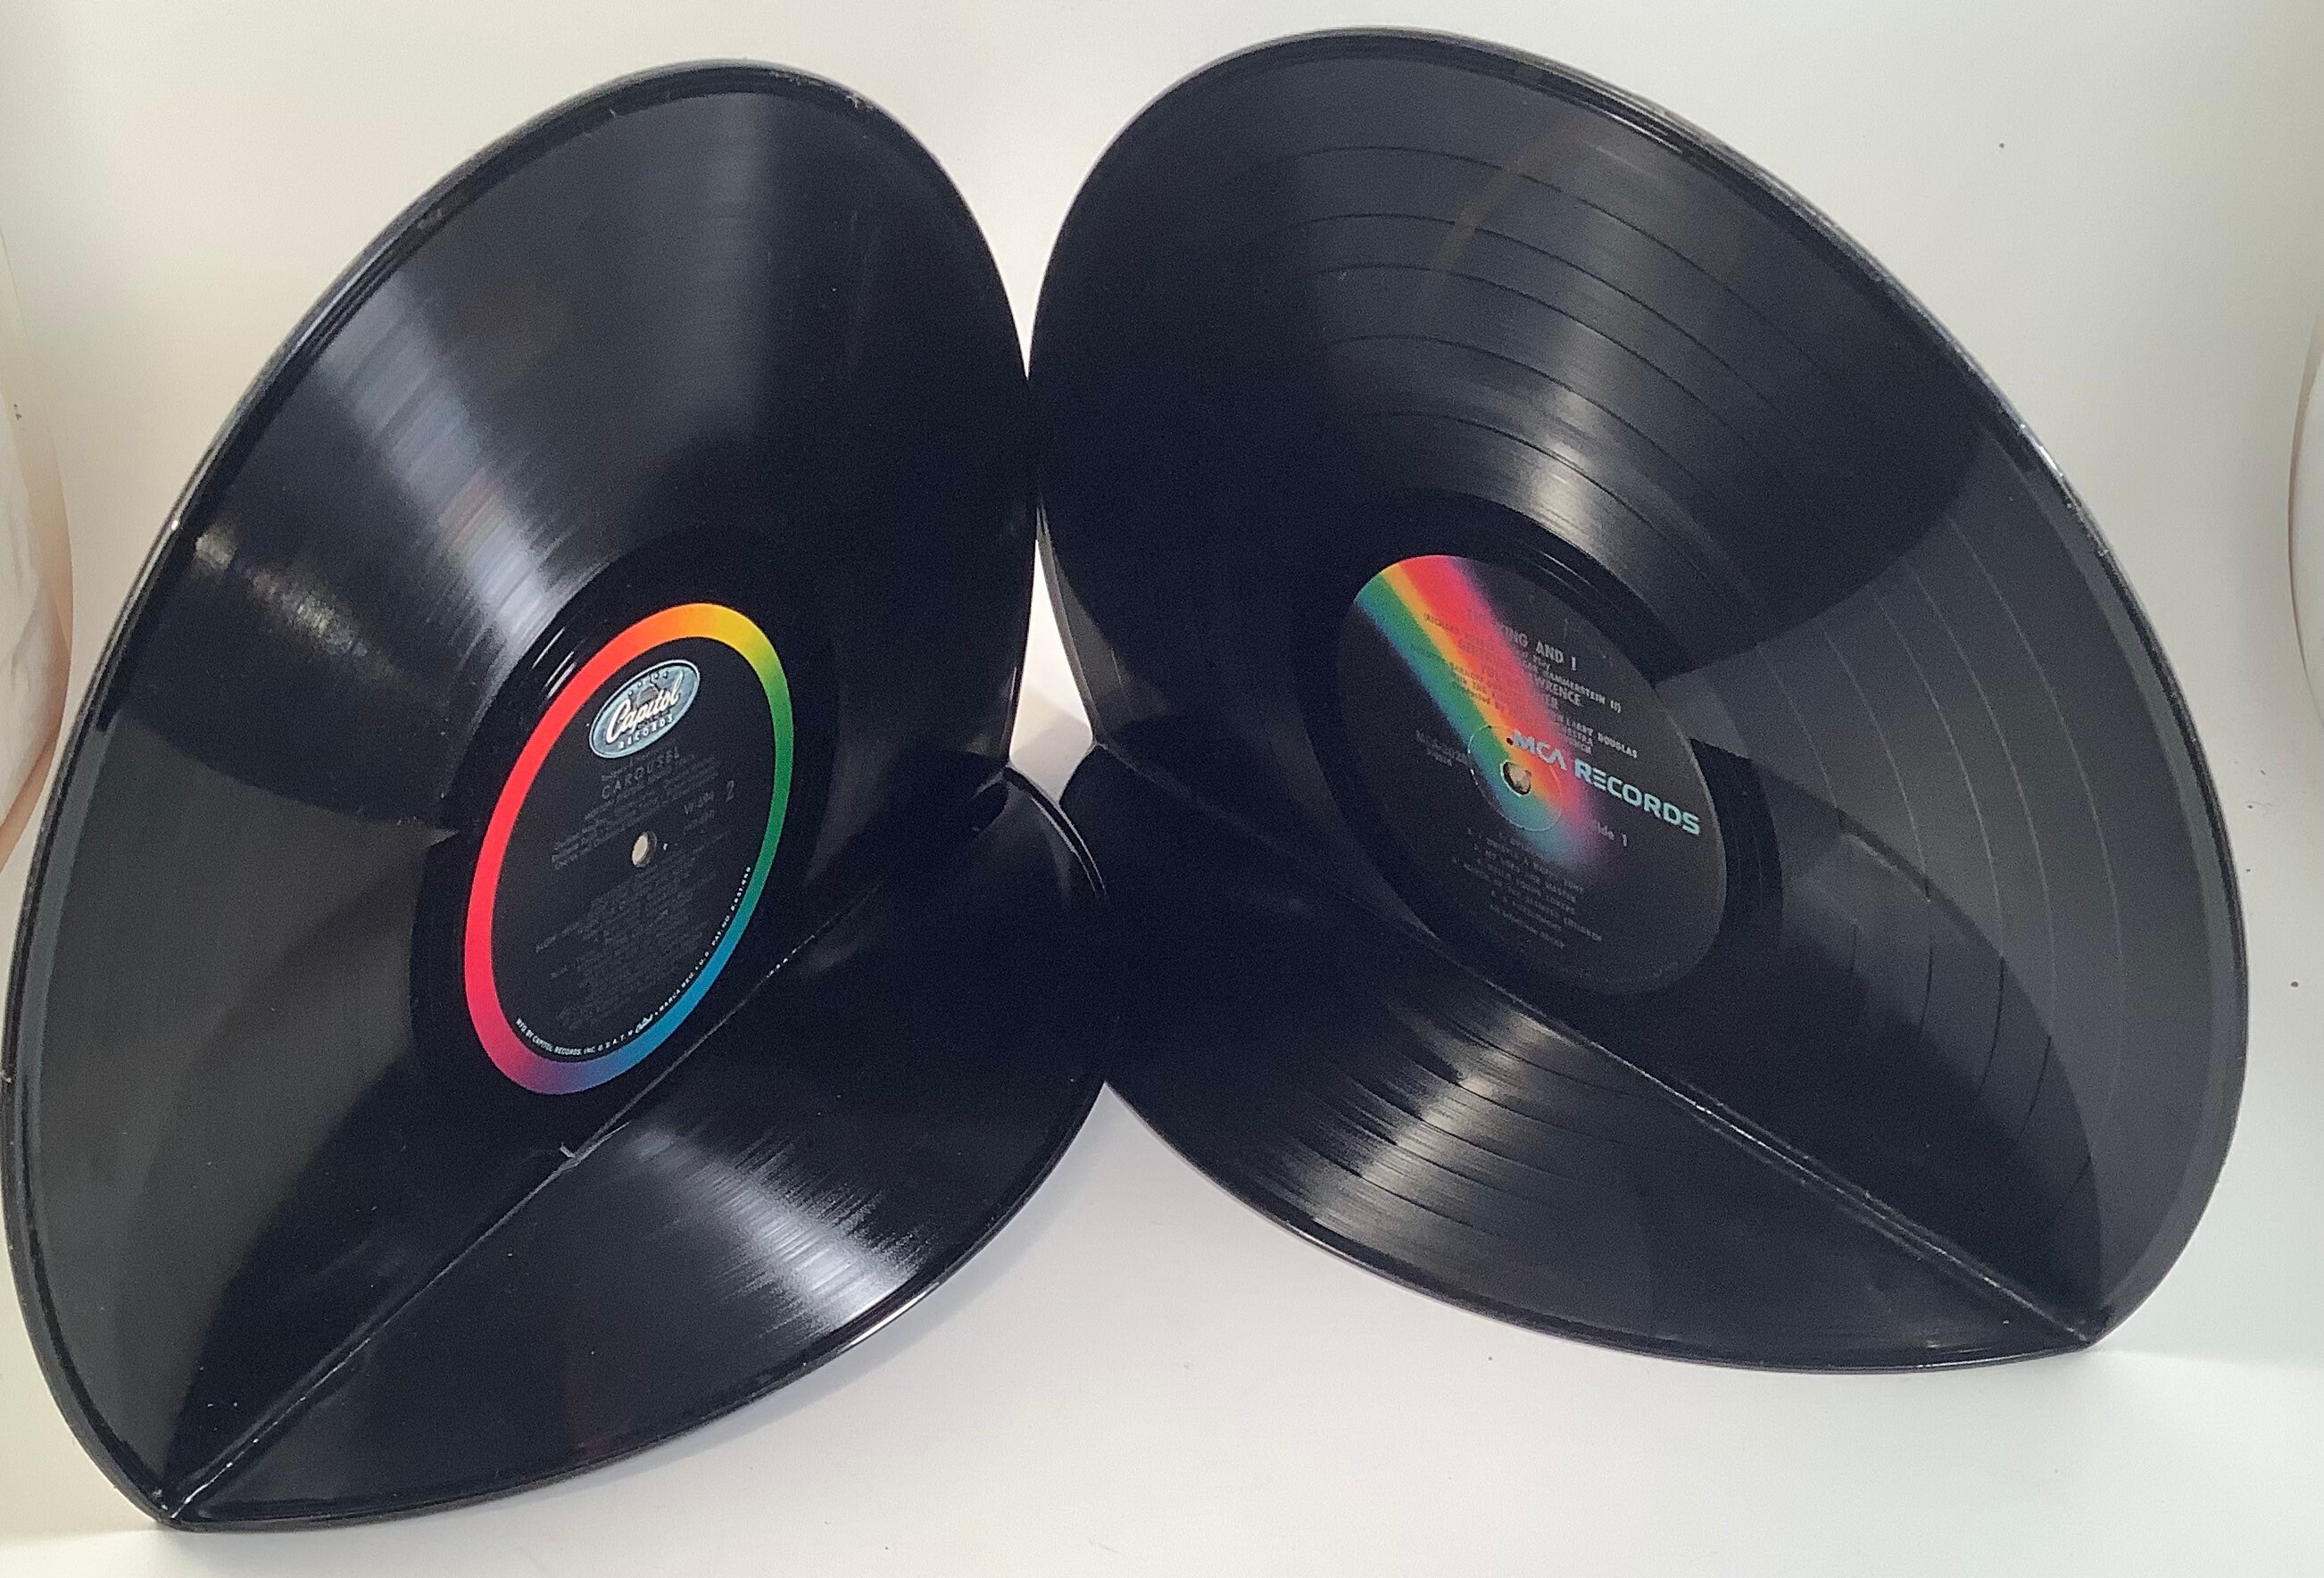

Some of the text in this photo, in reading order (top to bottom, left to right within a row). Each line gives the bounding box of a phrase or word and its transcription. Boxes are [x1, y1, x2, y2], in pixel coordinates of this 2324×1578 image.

[1535, 640, 1565, 664] AND
[1571, 656, 1577, 671] I
[606, 670, 684, 743] Capitol
[726, 779, 735, 802] 2
[1513, 728, 1567, 770] MCA
[1574, 759, 1700, 835] RECORDS
